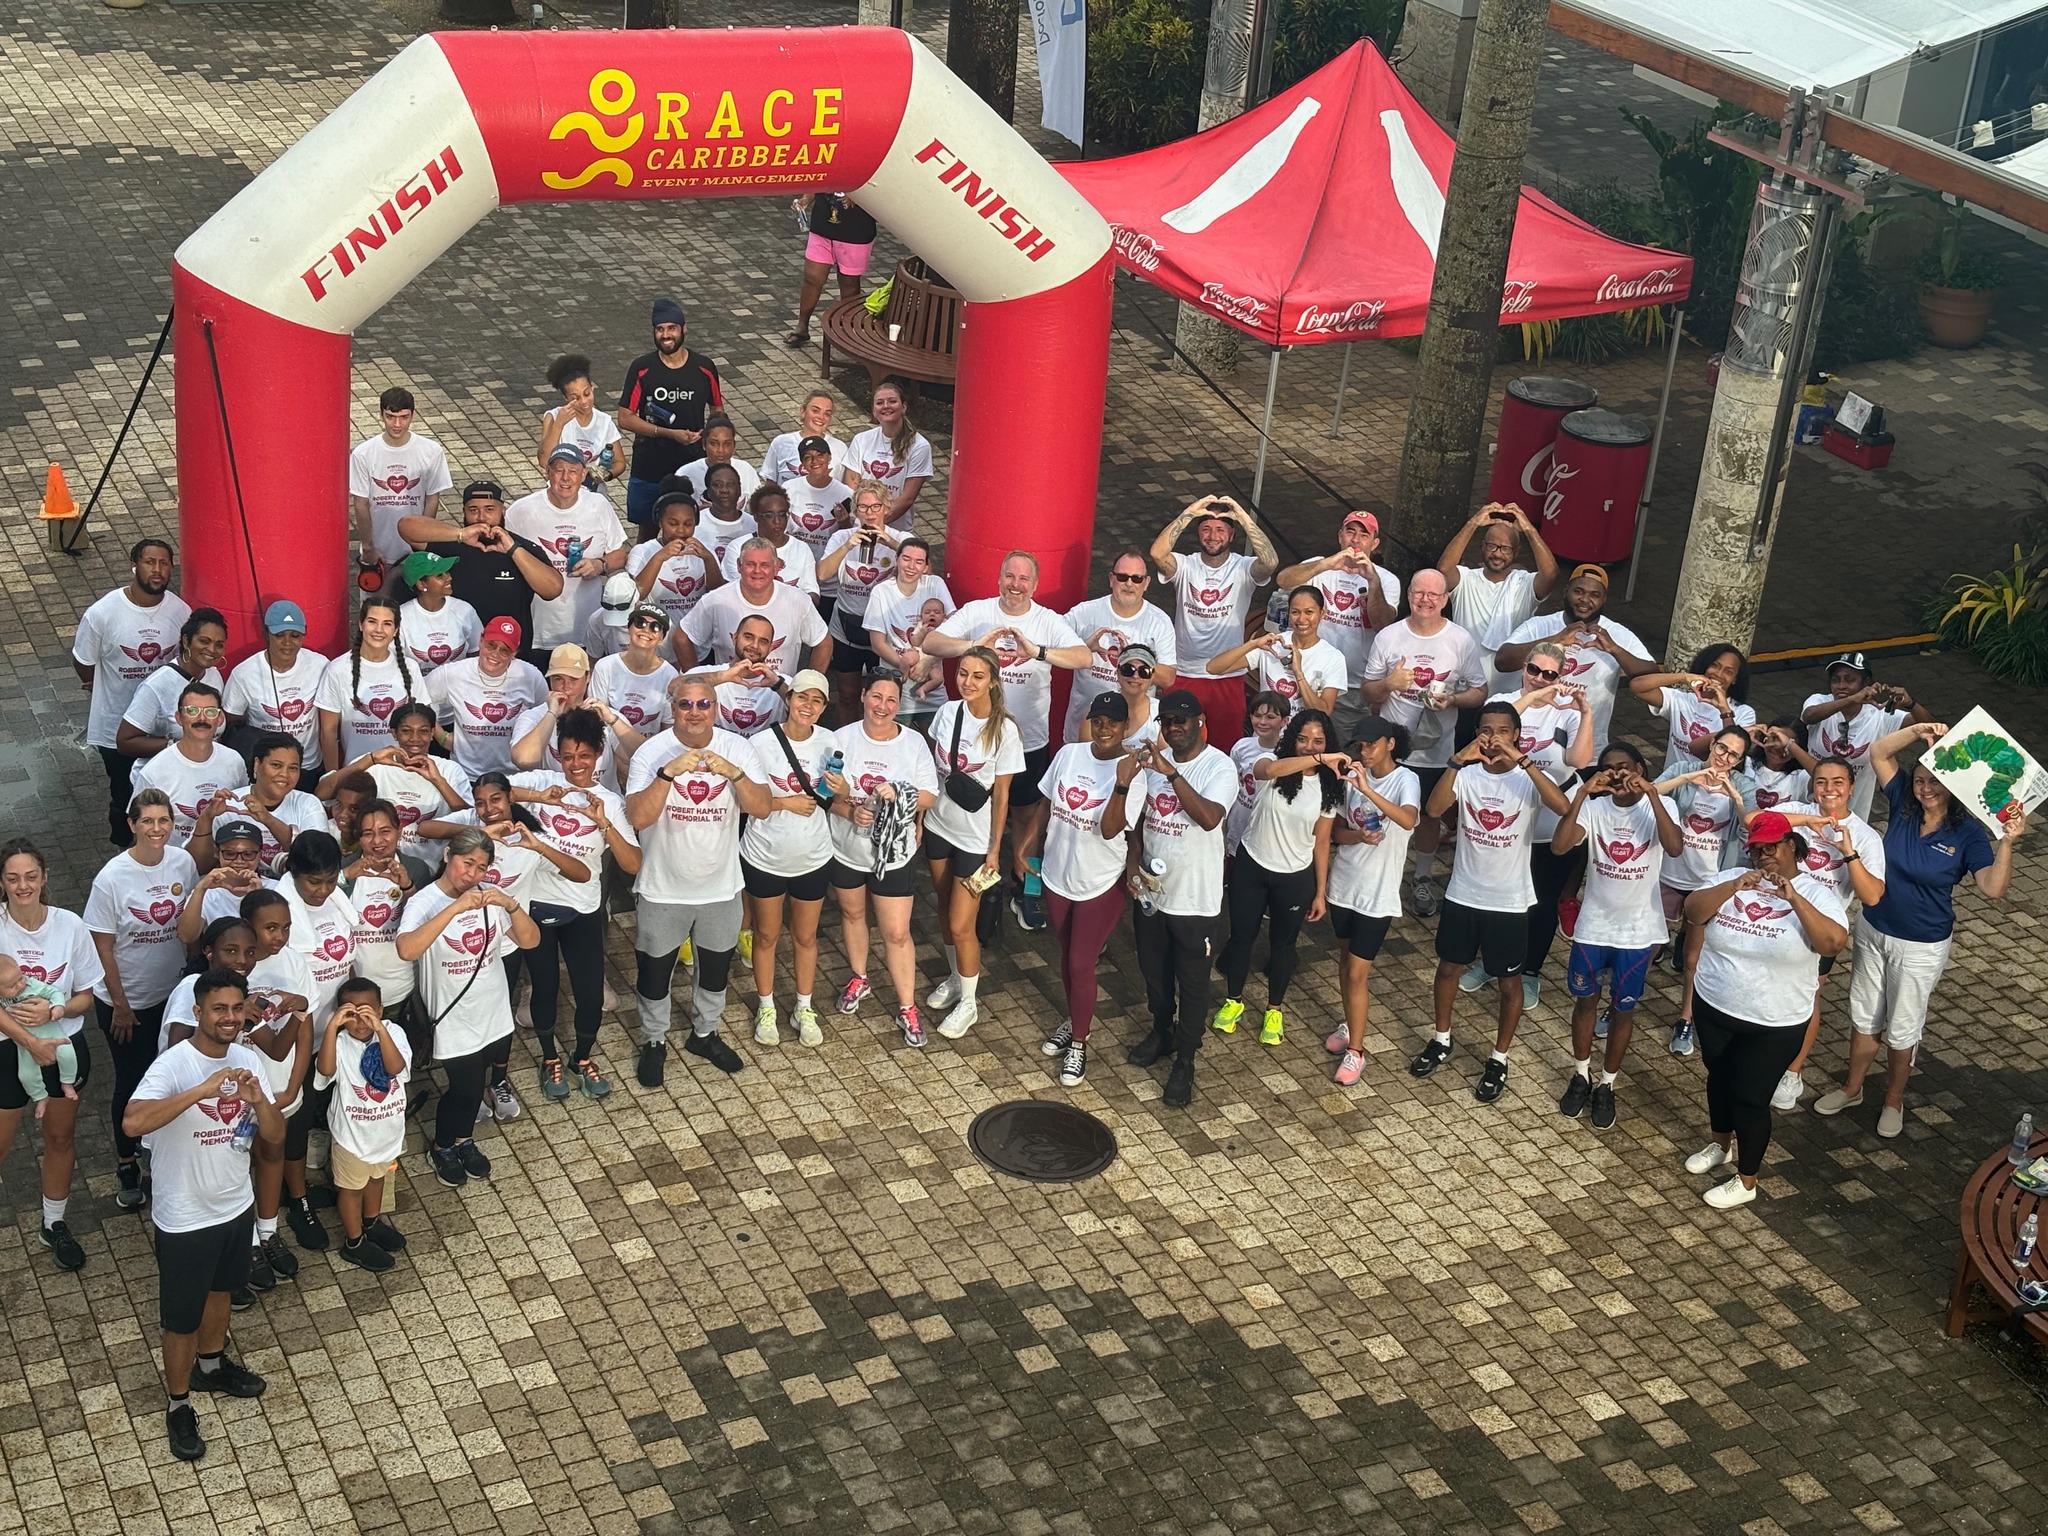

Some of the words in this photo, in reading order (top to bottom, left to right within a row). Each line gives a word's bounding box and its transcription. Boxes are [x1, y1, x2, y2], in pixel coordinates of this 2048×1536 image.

[654, 88, 843, 140] RACE
[647, 143, 838, 170] CARIBBEAN
[641, 178, 699, 188] EVENT
[702, 172, 828, 186] MANAGEMENT
[914, 137, 1055, 262] FINISH
[300, 145, 463, 302] FINISH
[654, 386, 695, 406] Ogier
[1323, 615, 1352, 627] EMORIAL
[1092, 665, 1113, 675] OBERT
[1091, 672, 1119, 683] MEMORIA
[1559, 680, 1588, 691] HAMATY
[352, 722, 380, 730] ROBERT
[356, 729, 391, 737] MEMORIA
[666, 806, 694, 815] ROBERT
[696, 807, 728, 816] HAMATY
[671, 814, 710, 823] MEMORIAL
[712, 814, 723, 822] 5K
[1071, 813, 1099, 827] HAMATY
[1481, 817, 1500, 825] HEART
[1161, 820, 1189, 830] HAMATY
[1172, 829, 1183, 837] 5K
[1488, 832, 1519, 842] HAMATY
[559, 839, 596, 853] HAMATY
[576, 850, 587, 858] 5K
[1611, 848, 1630, 856] HEART
[1618, 865, 1650, 874] HAMATY
[1809, 872, 1842, 885] HAMATY
[155, 908, 172, 917] HEART
[367, 911, 387, 920] HEART
[1715, 918, 1763, 937] MEMORIAL
[1716, 912, 1748, 927] ROBERT
[1748, 923, 1787, 935] HAMATY
[129, 929, 160, 939] ROBERT
[132, 934, 174, 944] MEMORIAL
[355, 936, 395, 945] EMORIAL
[442, 958, 473, 968] ROBERT
[312, 965, 337, 976] OBERT
[345, 1105, 378, 1115] ROBERT
[350, 1110, 394, 1121] MEMORIAL
[193, 1128, 228, 1138] ROBERT
